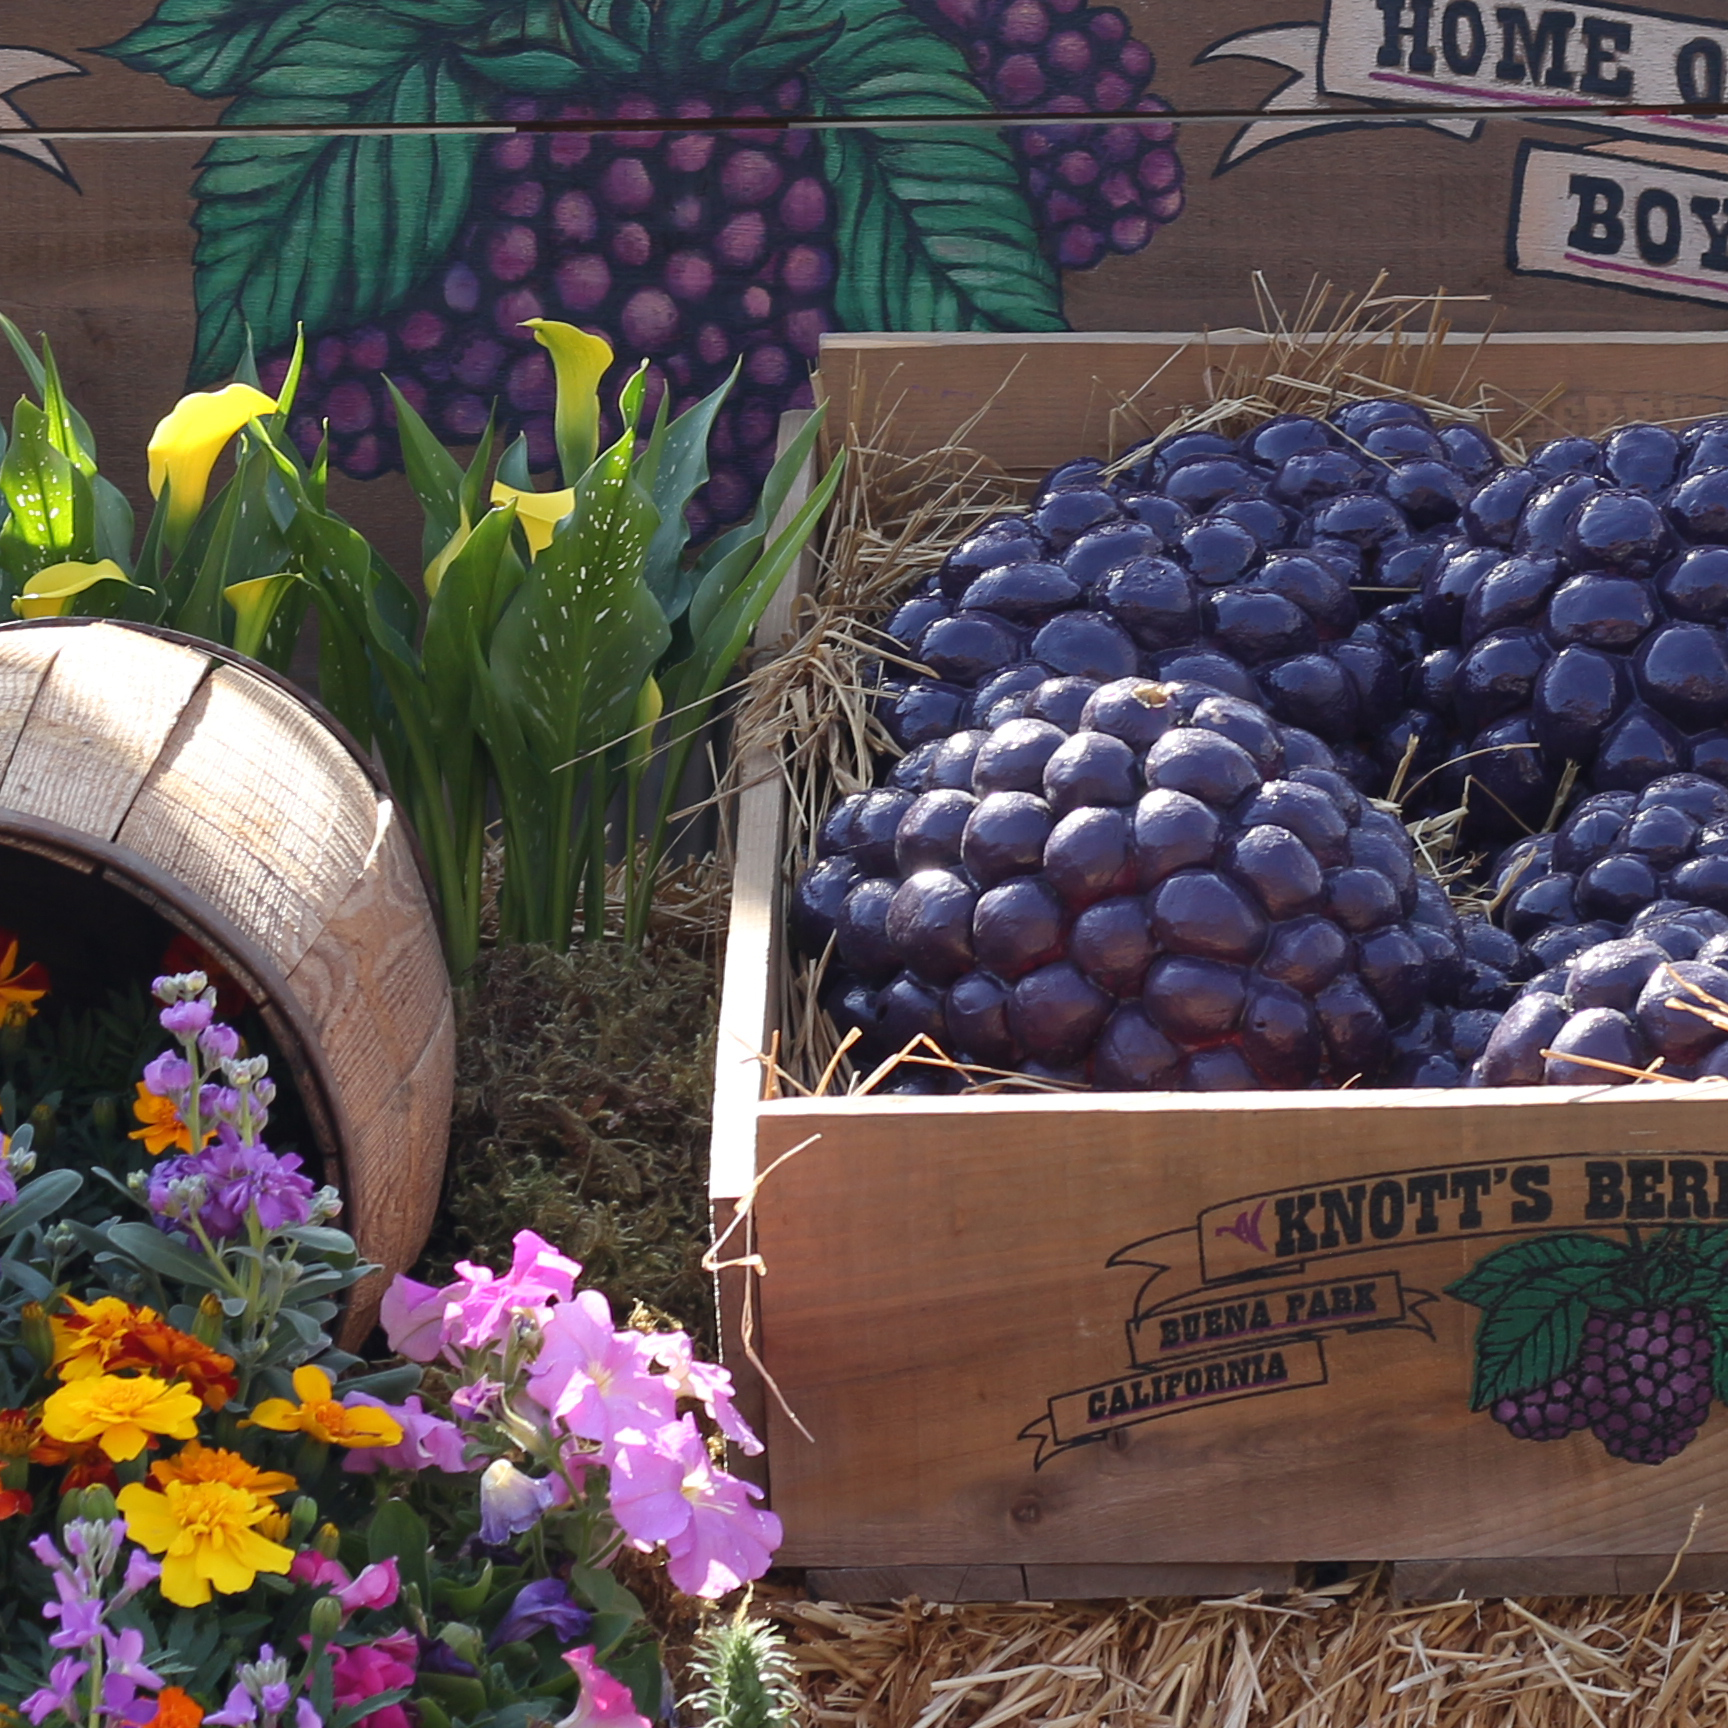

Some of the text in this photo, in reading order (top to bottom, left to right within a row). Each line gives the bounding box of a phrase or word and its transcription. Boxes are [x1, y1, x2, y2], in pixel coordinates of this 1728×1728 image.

[1274, 1164, 1552, 1258] KNOTT'S
[1159, 1282, 1377, 1349] BUENA PARK
[1087, 1351, 1288, 1420] CALIFORNIA
